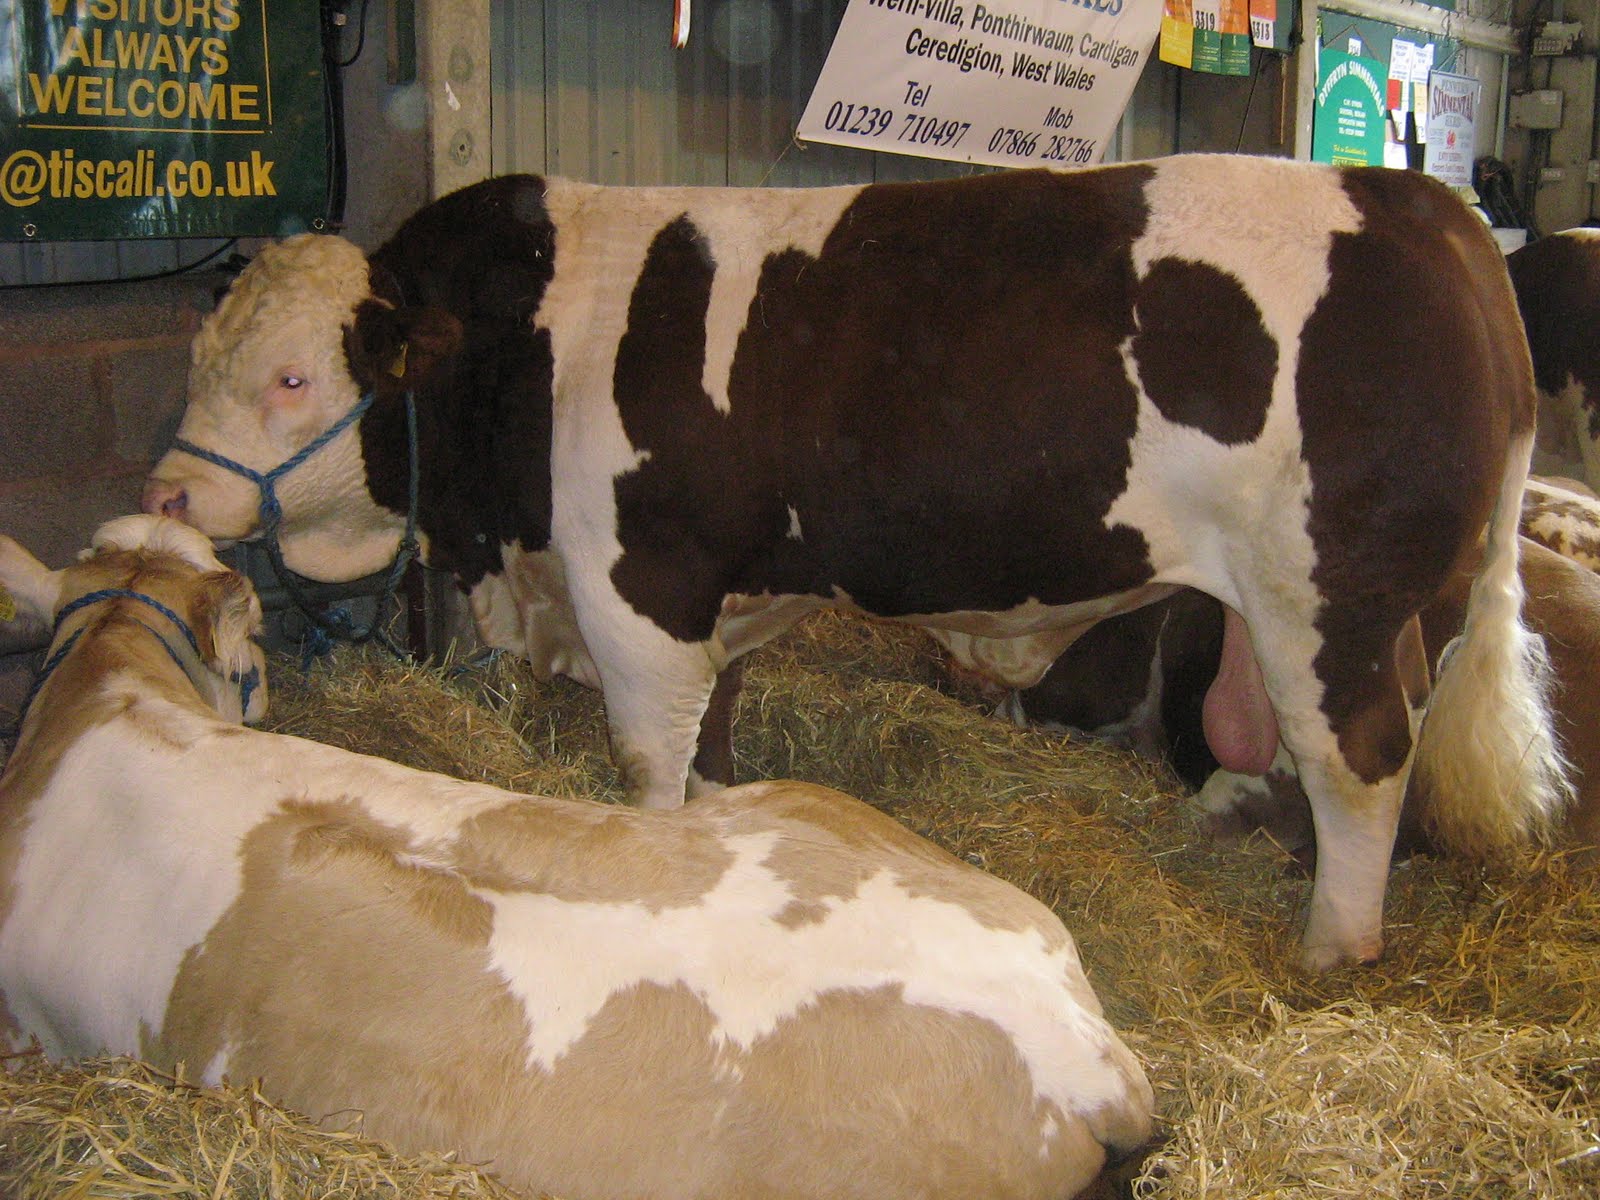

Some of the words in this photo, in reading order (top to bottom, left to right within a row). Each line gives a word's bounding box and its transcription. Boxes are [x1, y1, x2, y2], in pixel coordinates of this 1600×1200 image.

[869, 0, 964, 32] ern-Villa,
[970, 4, 1075, 54] Ponthirwaun,
[1079, 33, 1138, 69] Cardigan
[1195, 10, 1215, 31] 3319
[56, 27, 229, 76] ALWAYS
[905, 27, 1005, 78] Ceredigion,
[1012, 51, 1053, 83] West
[1054, 62, 1096, 92] Wales
[28, 73, 260, 121] WELCOME
[904, 81, 931, 107] Tel
[1043, 106, 1073, 129] Mob
[825, 100, 893, 137] 01239
[897, 113, 971, 149] 710497
[988, 127, 1041, 157] 07866
[1041, 134, 1096, 164] 282766
[0, 149, 278, 207] @tiscali.co.uk
